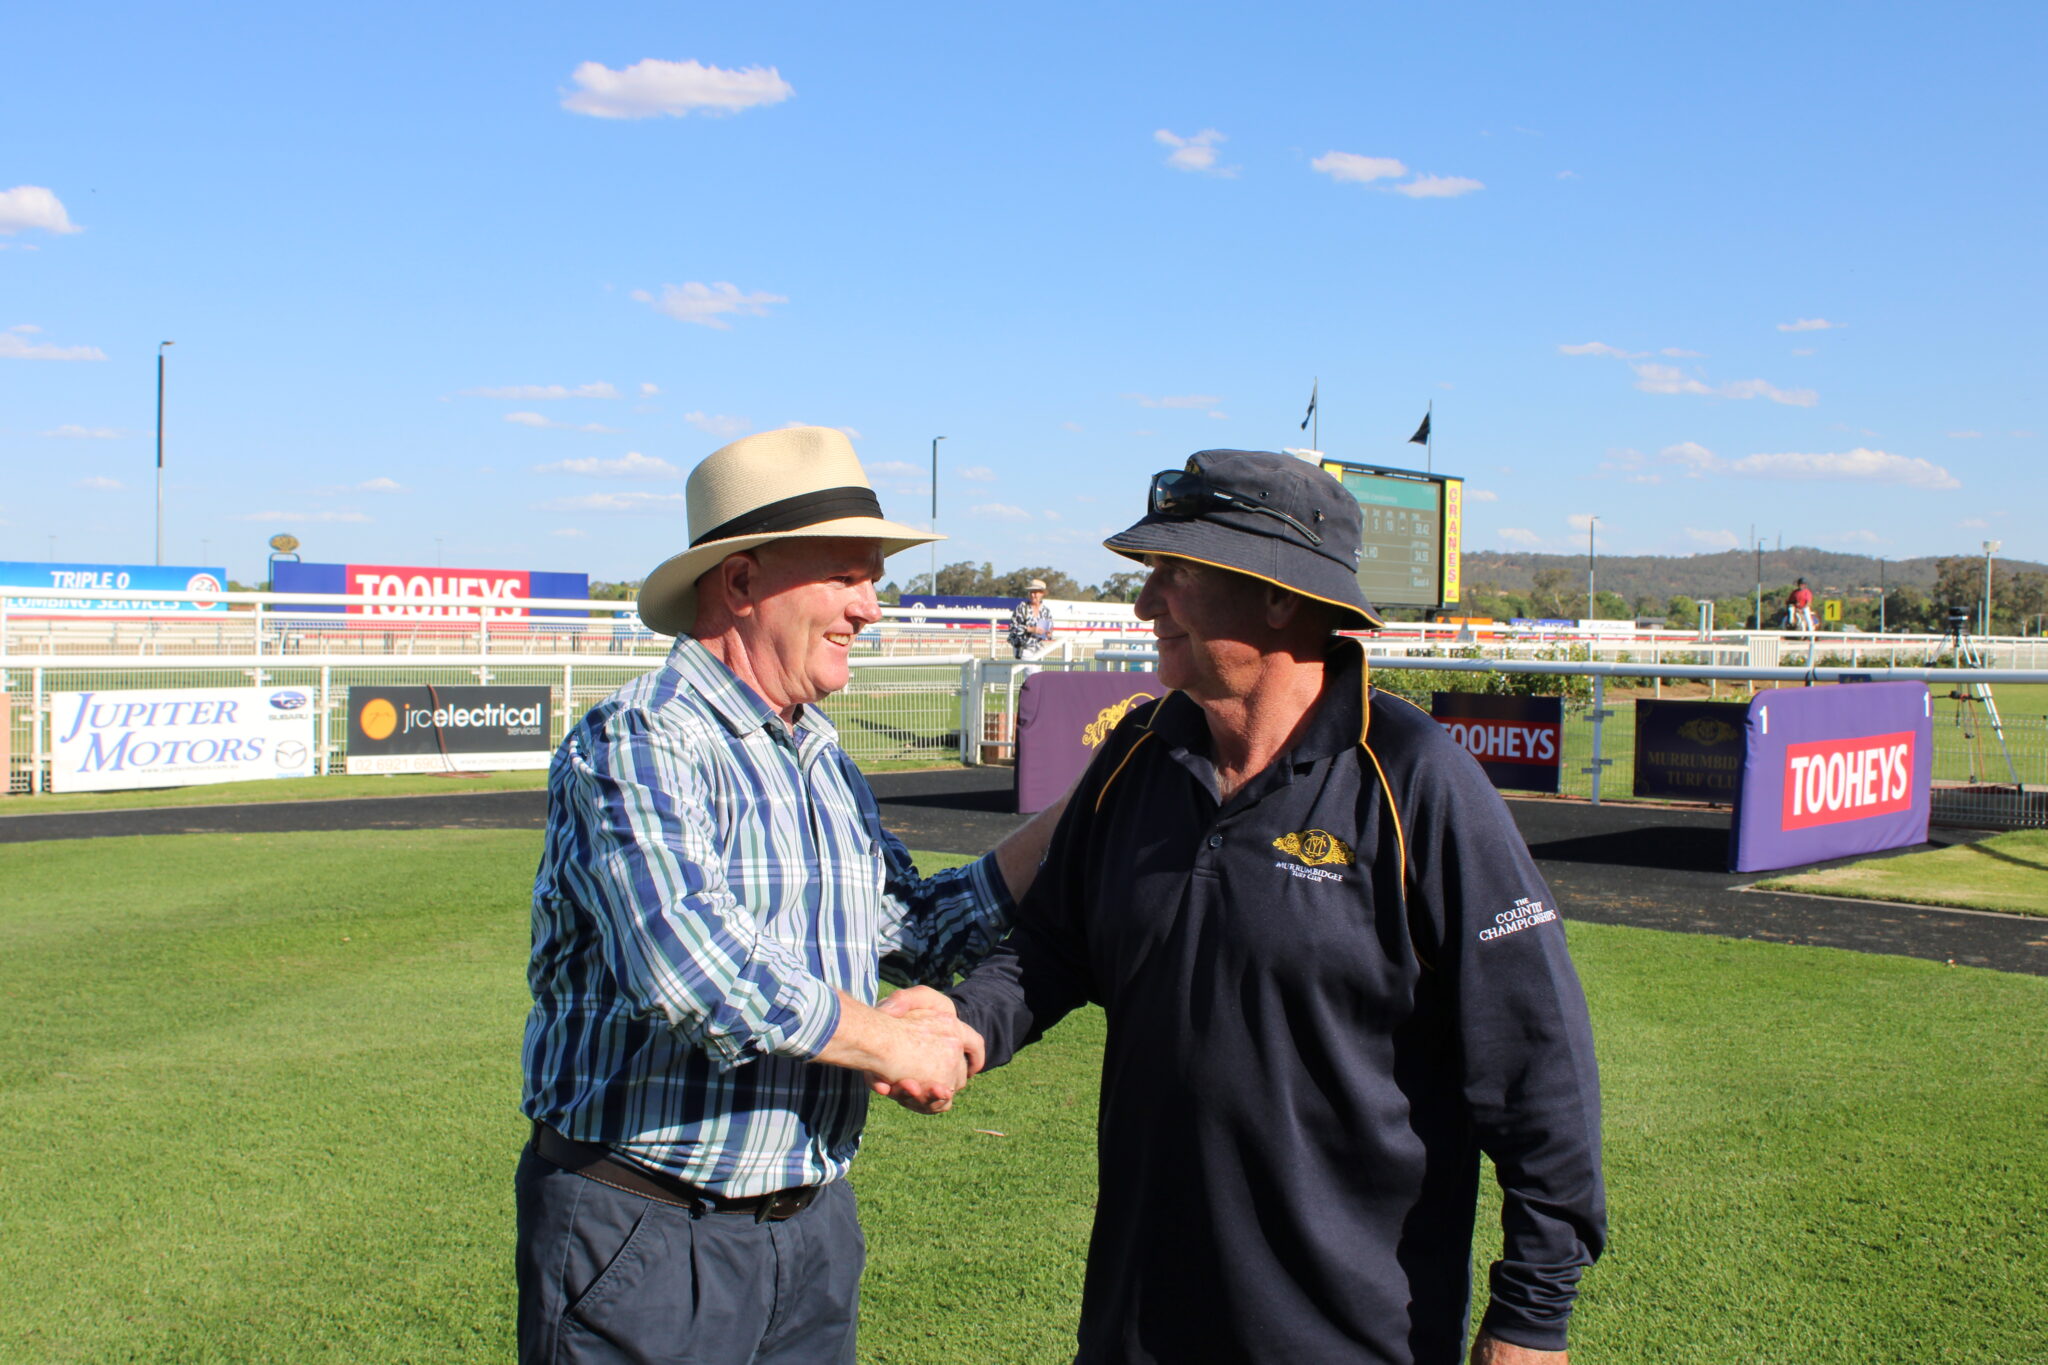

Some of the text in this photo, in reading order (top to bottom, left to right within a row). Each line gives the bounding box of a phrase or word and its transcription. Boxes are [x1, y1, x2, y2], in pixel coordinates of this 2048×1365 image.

[1448, 487, 1459, 583] CRANES
[51, 571, 114, 589] TRIPLE
[356, 574, 522, 617] TOOHEYS
[1827, 603, 1835, 618] 1
[1924, 691, 1930, 717] 1
[60, 692, 239, 743] JUPITER
[1759, 705, 1768, 735] 1
[76, 731, 265, 772] MOTORS
[1648, 751, 1738, 770] MURRUMBID
[1707, 773, 1737, 789] CLU
[1791, 744, 1908, 816] TOOHEYS
[1275, 861, 1344, 881] MURRUMBIDGEE
[1514, 897, 1530, 906] THE
